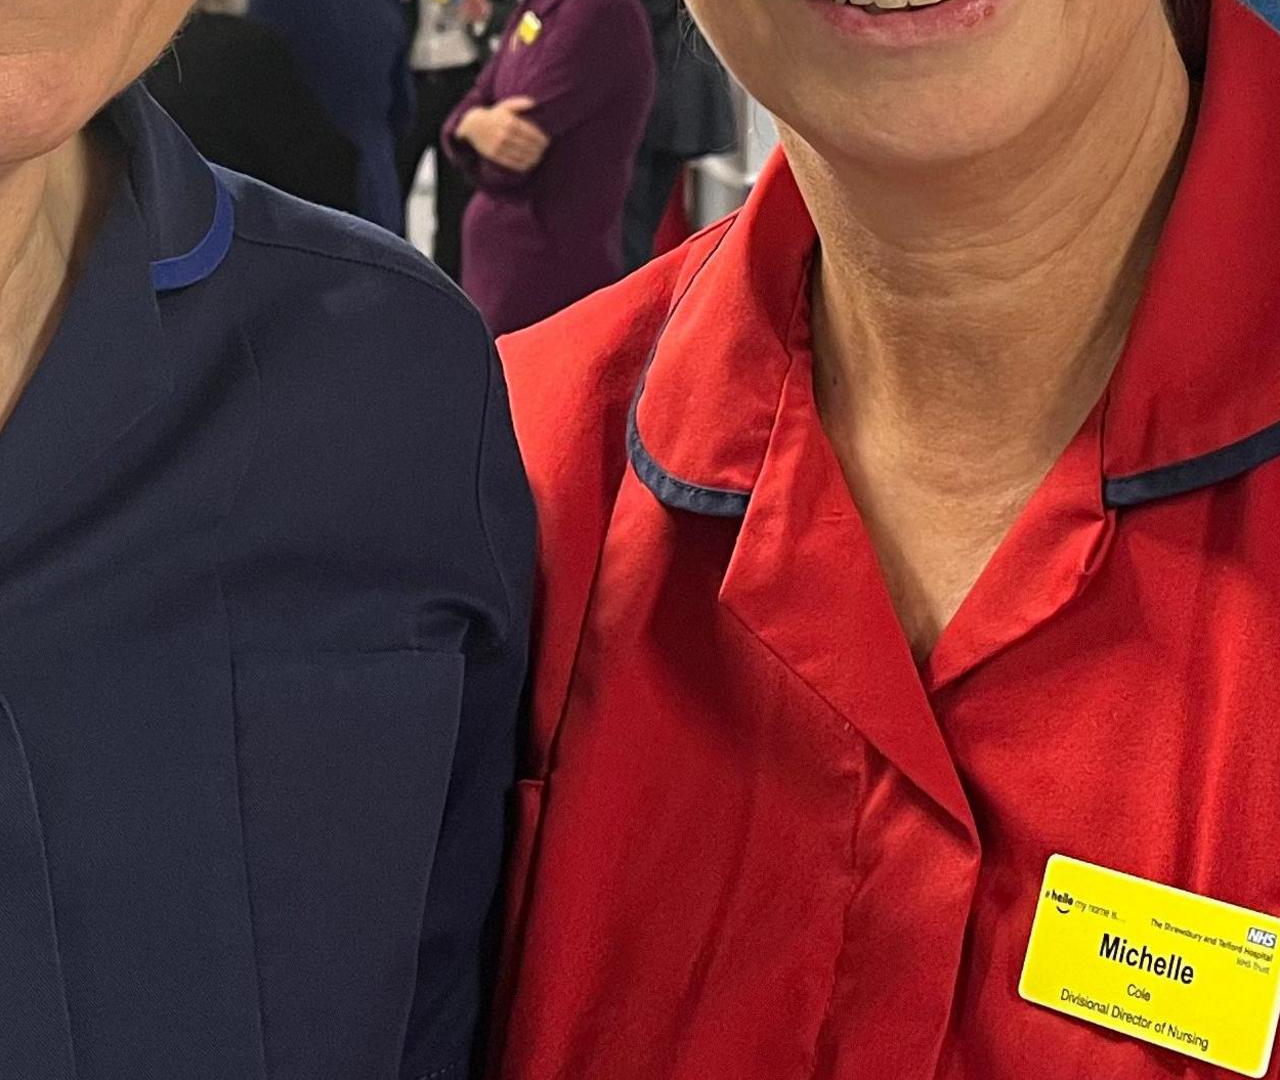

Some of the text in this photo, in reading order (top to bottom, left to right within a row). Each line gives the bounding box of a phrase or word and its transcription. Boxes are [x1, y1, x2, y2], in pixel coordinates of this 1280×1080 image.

[1051, 890, 1073, 906] hello
[1151, 918, 1163, 930] The
[1204, 933, 1217, 946] and
[1244, 947, 1273, 962] Hospital
[1248, 928, 1276, 948] NHS
[1100, 933, 1194, 984] Michelle
[1127, 984, 1151, 1002] Cole
[1061, 988, 1209, 1051] Divisional Director of Nursing
